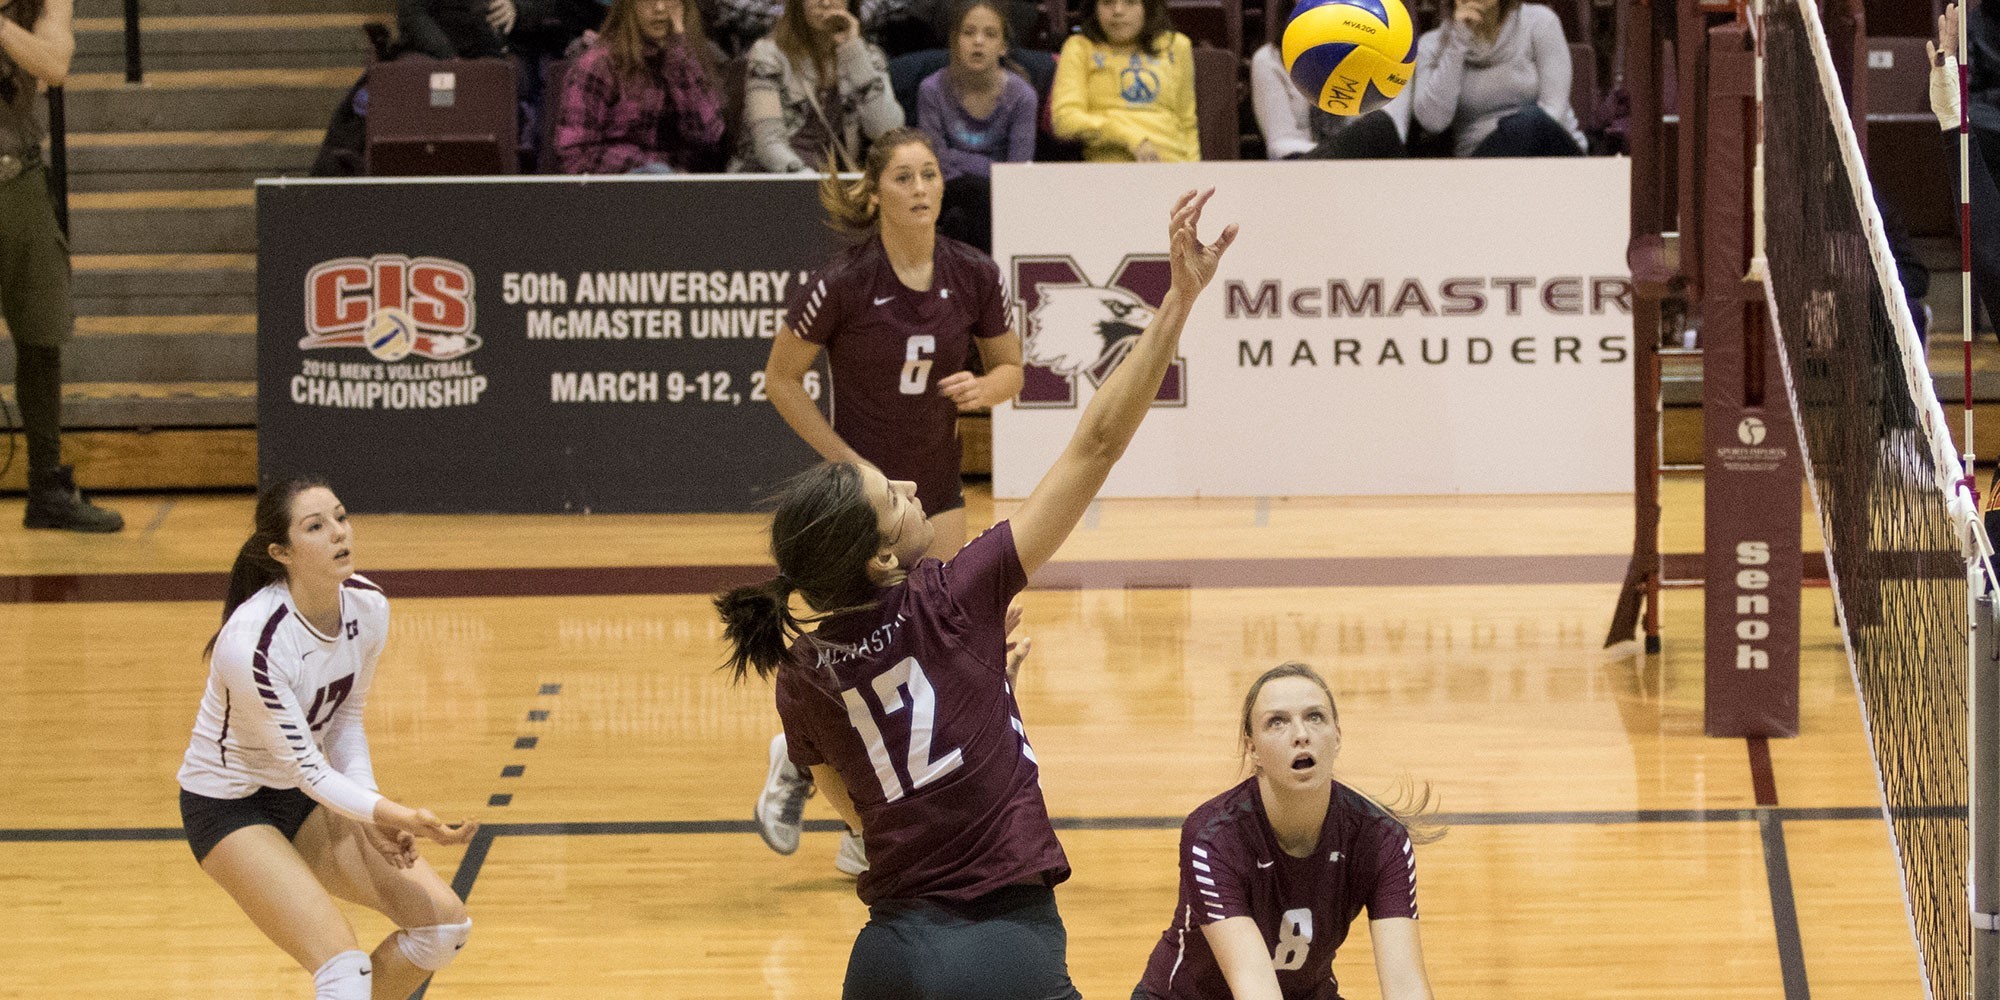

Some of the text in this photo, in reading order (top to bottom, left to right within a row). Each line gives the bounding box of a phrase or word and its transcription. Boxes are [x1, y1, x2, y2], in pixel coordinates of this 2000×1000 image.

[1342, 19, 1376, 35] MVA200
[1327, 75, 1360, 110] MAC
[309, 258, 472, 333] CIS
[503, 272, 567, 304] 50th
[575, 271, 790, 303] ANNIVERSARY
[1224, 276, 1632, 319] McMASTER
[526, 309, 682, 340] McMASTER
[899, 335, 936, 395] 6
[1238, 336, 1628, 367] MARAUDERS
[302, 360, 475, 380] 2016 MEN'S VOLLEYBALL
[551, 370, 821, 406] MARCH 9-12, 26
[291, 374, 488, 409] CHAMPIONSHIP
[1736, 541, 1771, 670] Senoh
[306, 672, 355, 732] 17
[841, 655, 964, 803] 12
[1274, 907, 1313, 971] 8
